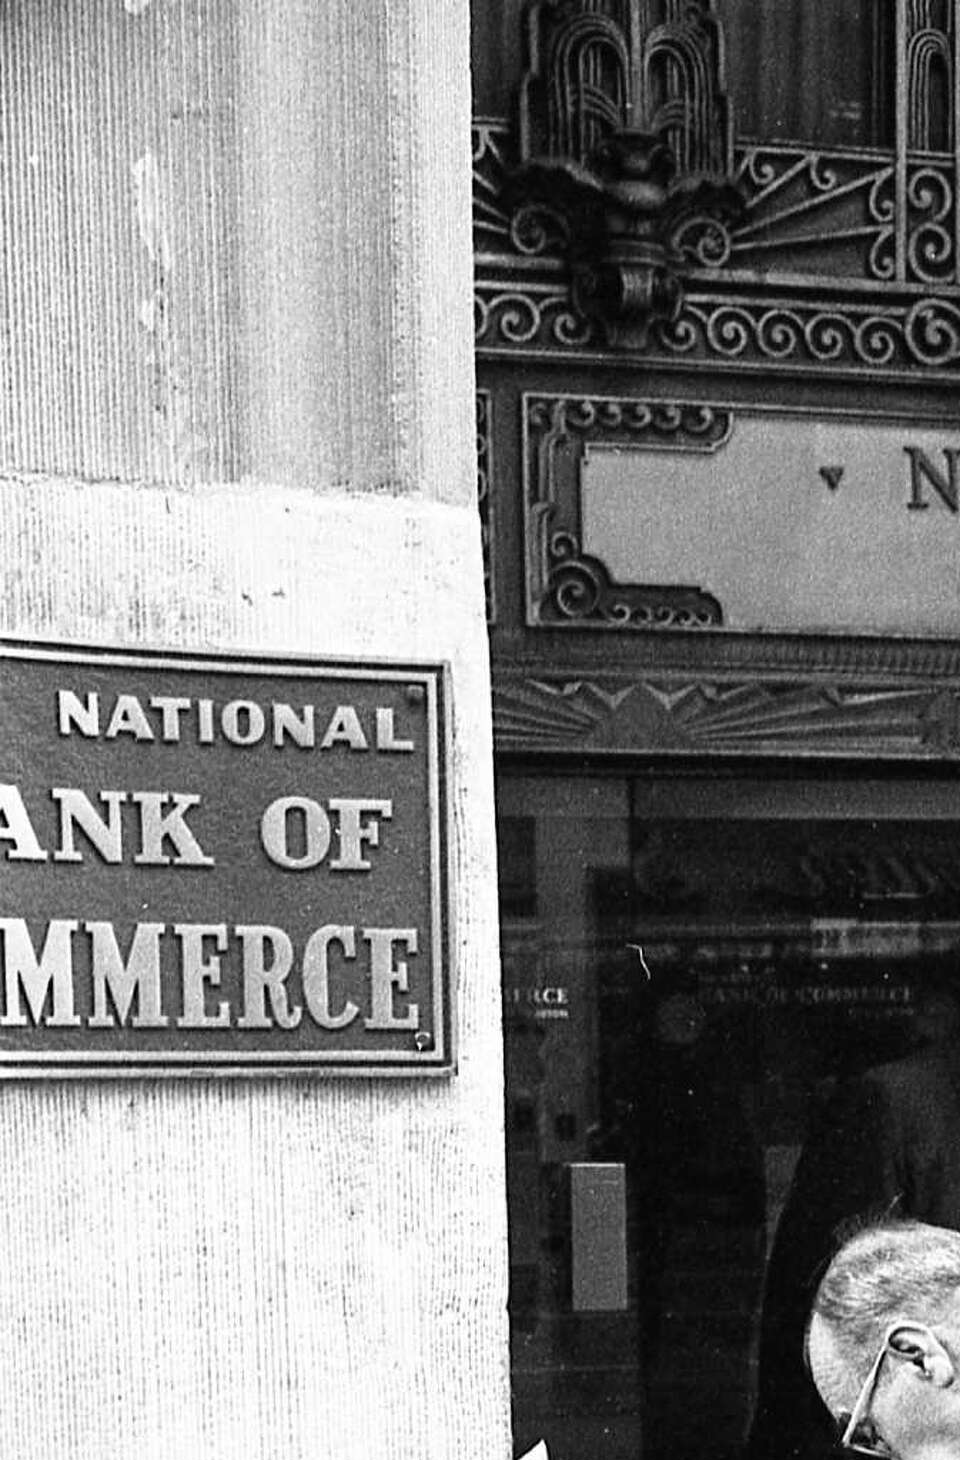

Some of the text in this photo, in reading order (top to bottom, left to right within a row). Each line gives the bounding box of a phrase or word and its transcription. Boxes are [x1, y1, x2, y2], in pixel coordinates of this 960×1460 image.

[57, 689, 415, 752] NATIONAL
[261, 796, 393, 871] OF
[0, 916, 420, 1031] MMERCE
